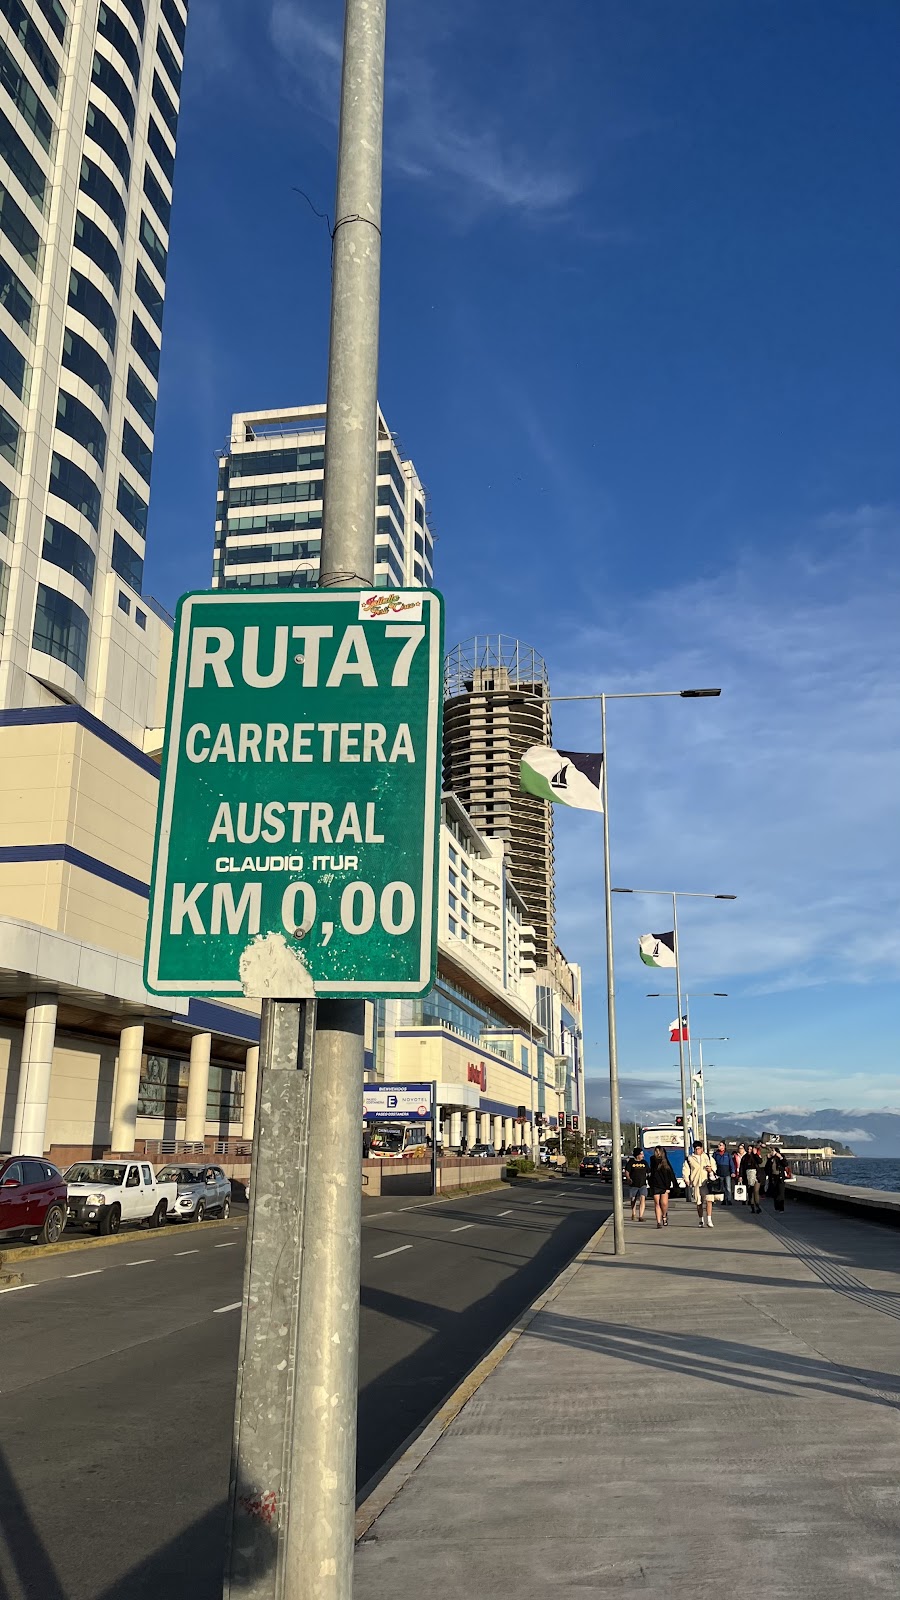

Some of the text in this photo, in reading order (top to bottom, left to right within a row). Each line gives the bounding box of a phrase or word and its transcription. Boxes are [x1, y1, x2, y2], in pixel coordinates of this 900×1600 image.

[186, 723, 416, 763] CARRETERA
[208, 801, 385, 844] AUSTRAL
[215, 855, 359, 872] CLAUDIO ITUR
[169, 881, 416, 946] KM 0,00
